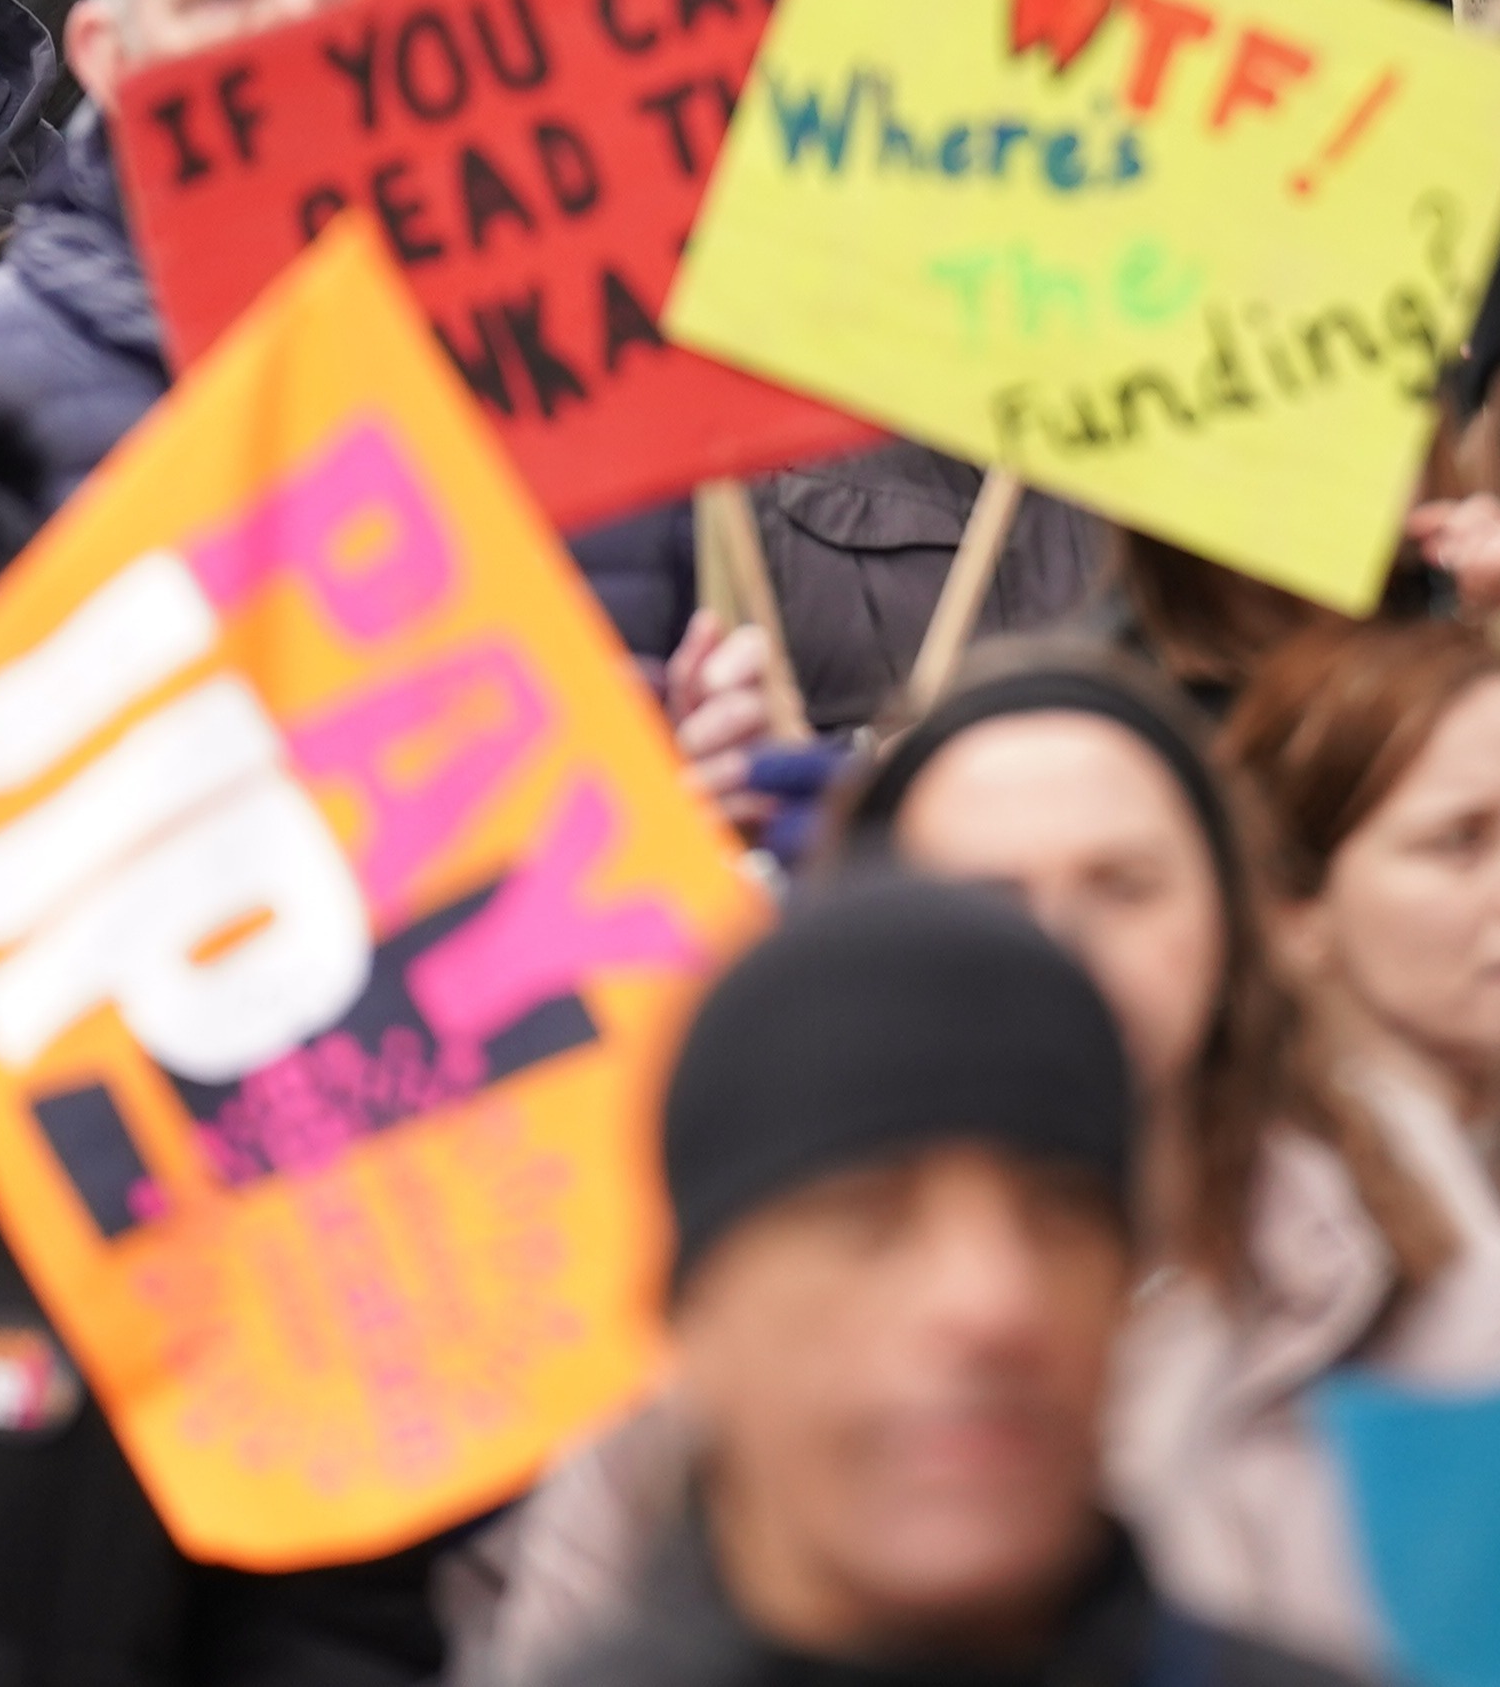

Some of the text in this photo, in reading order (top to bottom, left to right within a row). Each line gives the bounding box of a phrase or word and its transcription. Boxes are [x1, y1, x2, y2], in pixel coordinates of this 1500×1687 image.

[152, 67, 263, 184] IF
[922, 228, 1204, 354] The
[183, 407, 703, 1044] PAY
